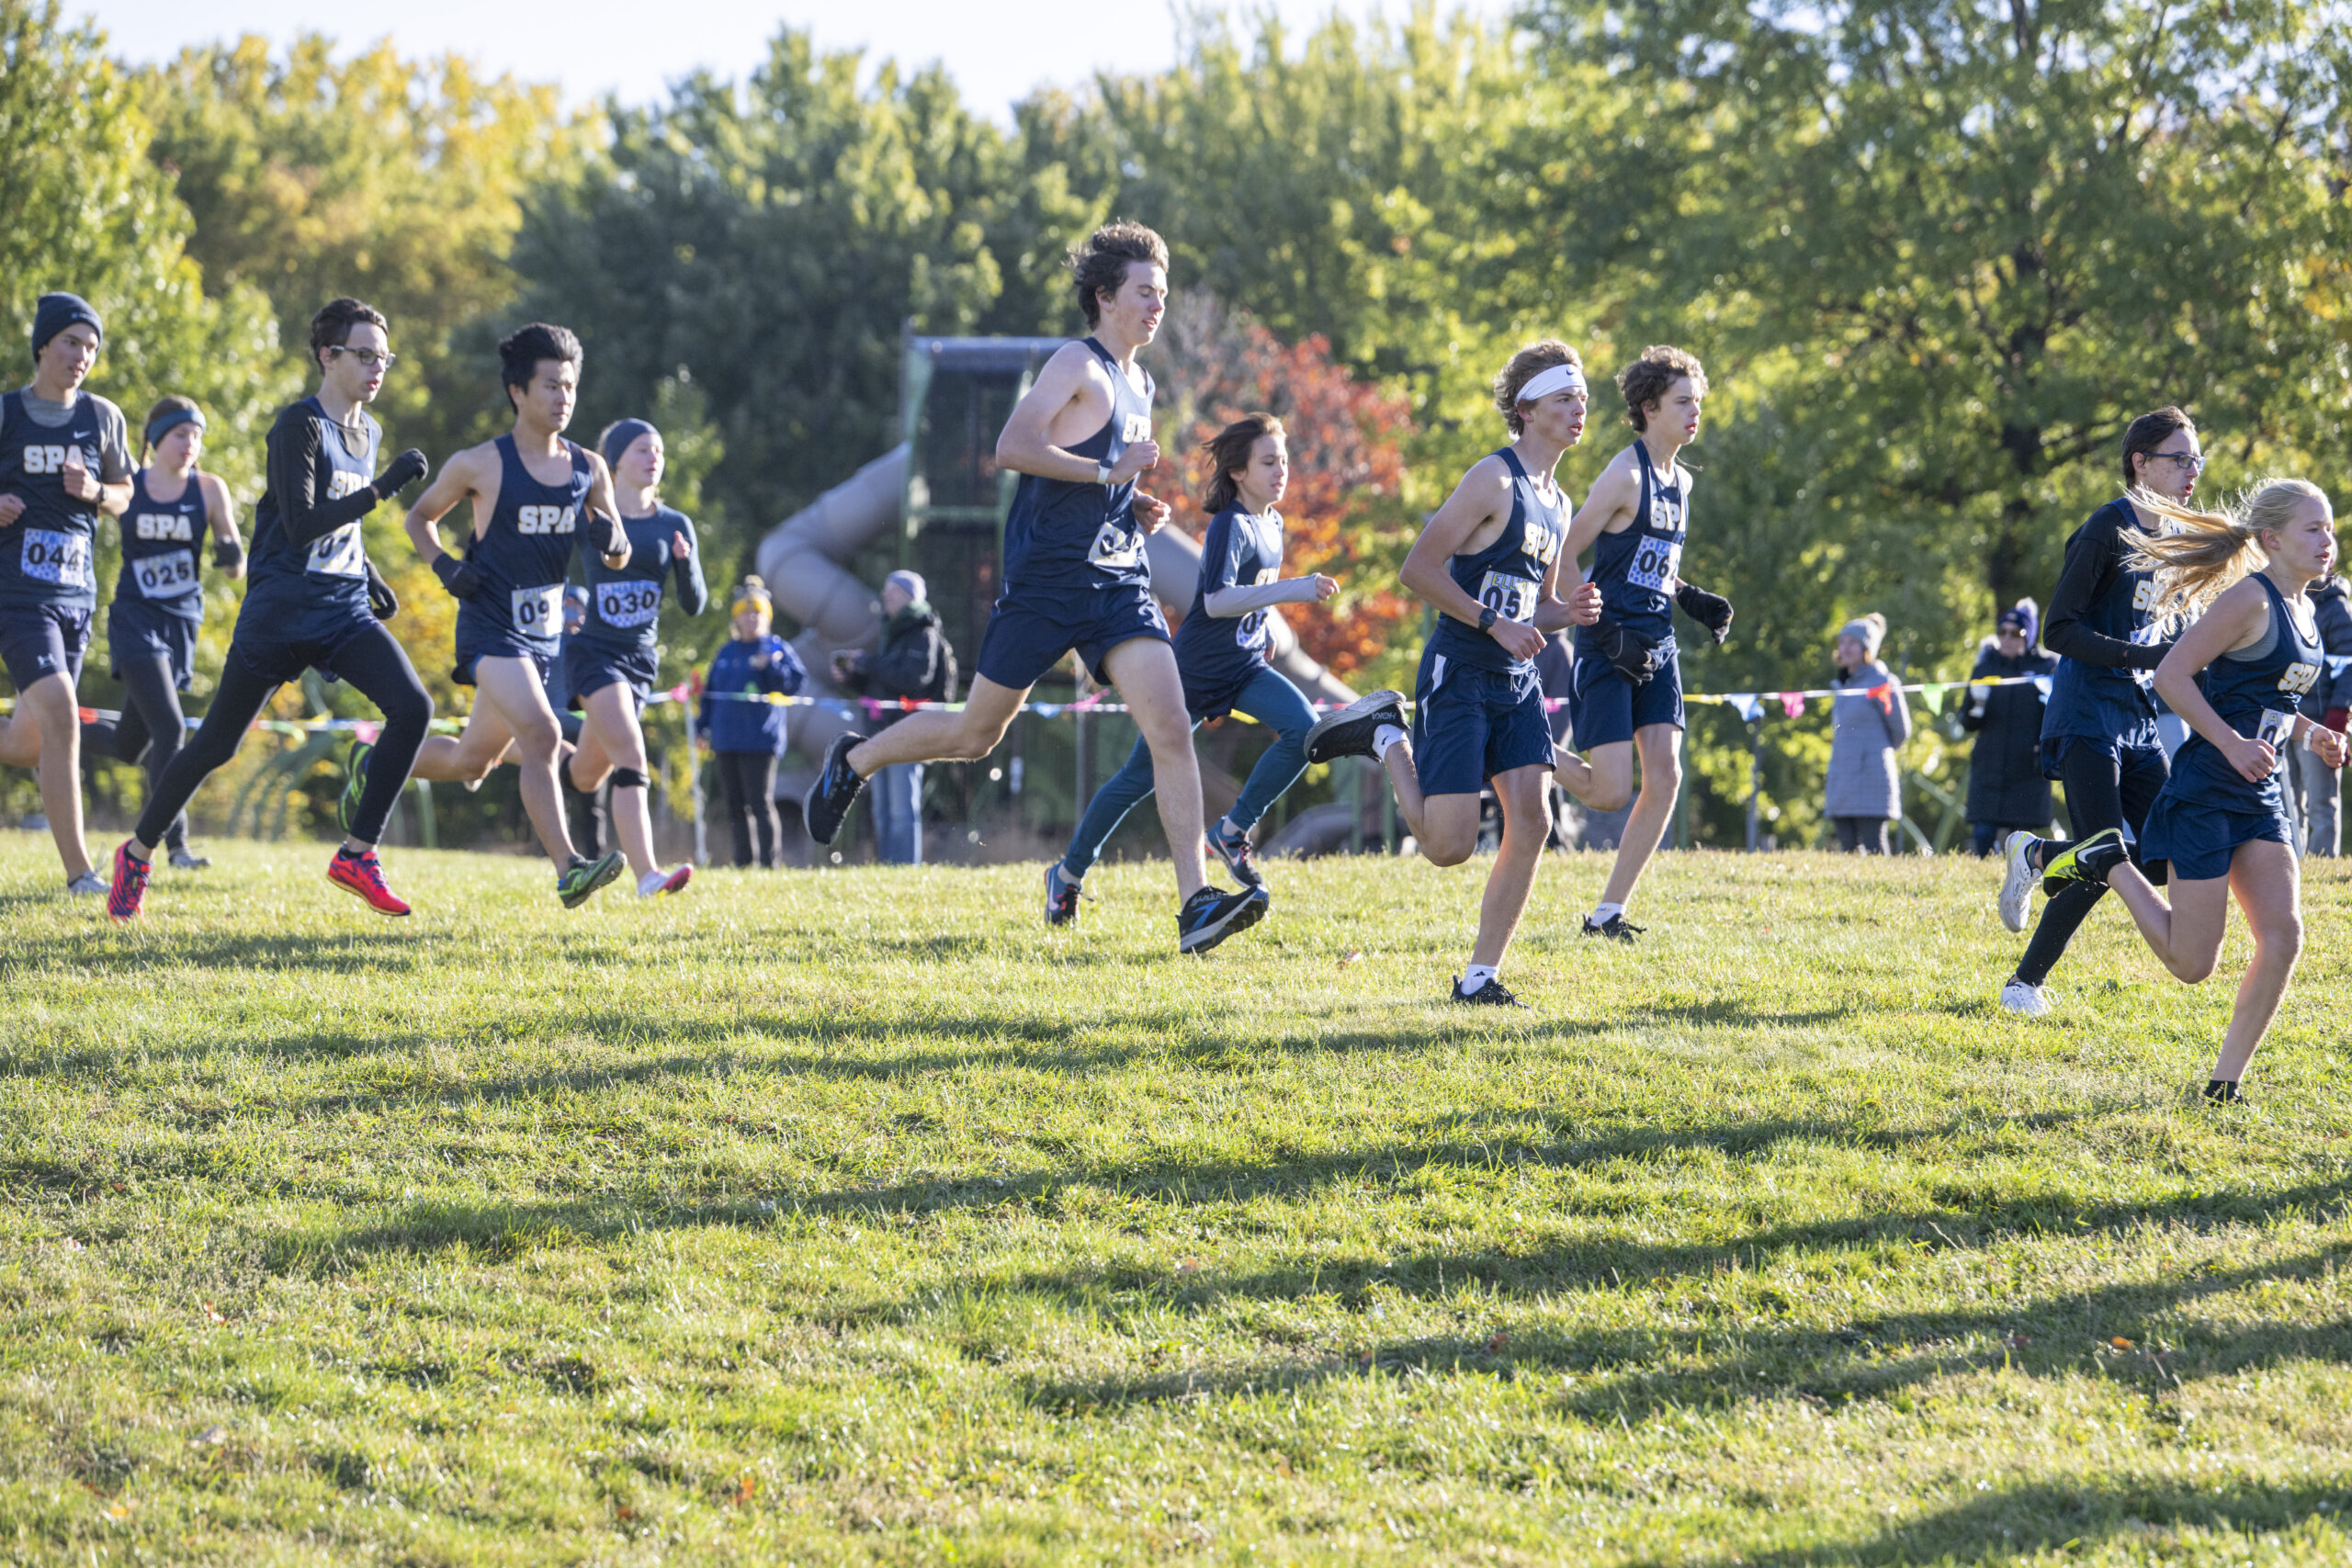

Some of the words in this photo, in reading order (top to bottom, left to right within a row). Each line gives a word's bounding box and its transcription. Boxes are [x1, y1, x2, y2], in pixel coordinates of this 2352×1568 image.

[136, 513, 193, 541] SPA
[518, 505, 576, 534] SPA
[28, 542, 81, 571] 044
[141, 561, 190, 588] 025
[605, 590, 655, 615] 030
